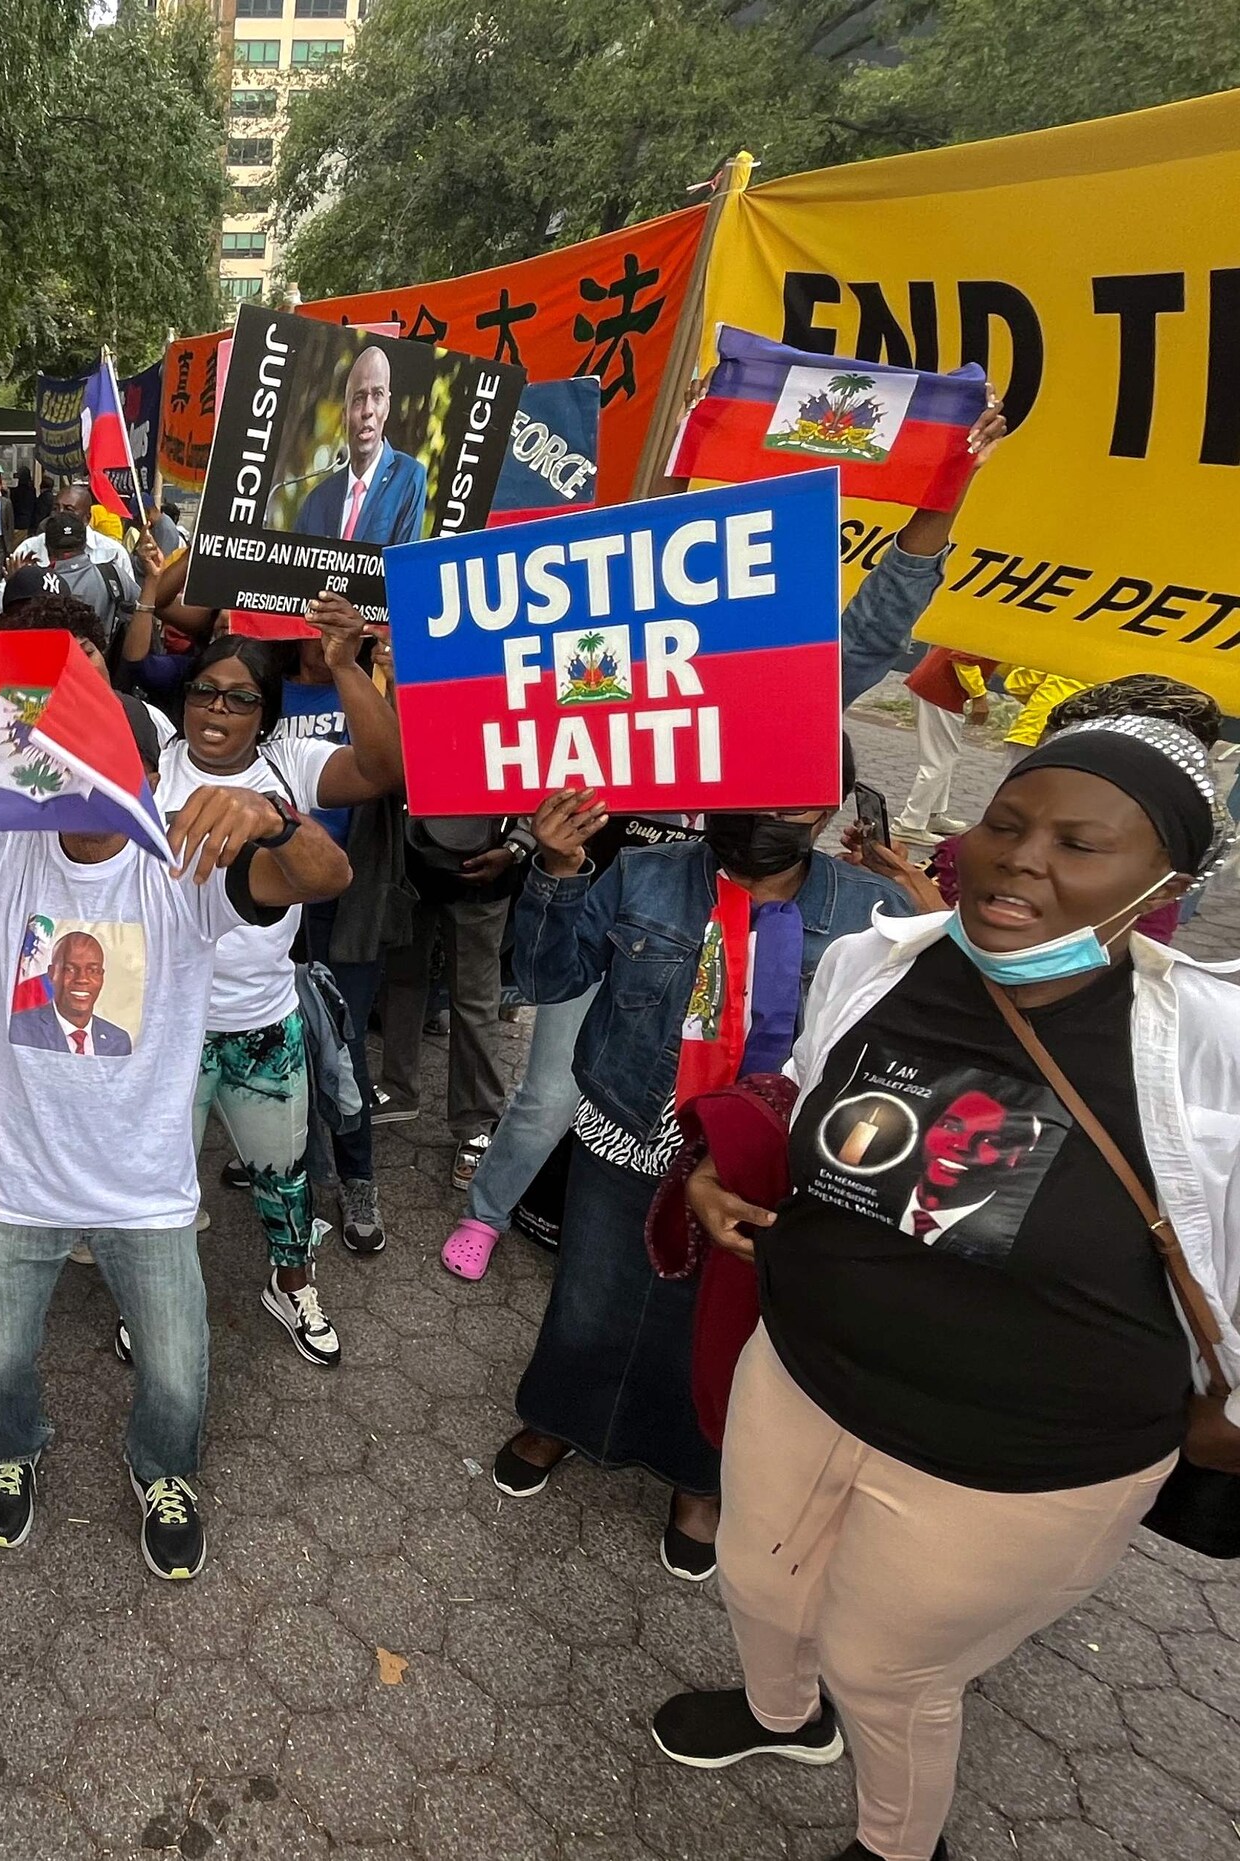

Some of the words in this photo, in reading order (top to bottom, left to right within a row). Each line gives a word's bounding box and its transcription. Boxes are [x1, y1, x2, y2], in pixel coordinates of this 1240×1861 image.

[230, 322, 291, 525] JUSTICE
[198, 533, 224, 557] WE
[225, 537, 266, 562] NEED
[267, 543, 290, 566] AN
[325, 575, 349, 593] FOR
[427, 510, 777, 638] JUSTICE
[949, 548, 1103, 613] THE
[235, 591, 300, 614] PRESIDENT
[482, 706, 722, 792] HAITI
[625, 820, 662, 844] July
[895, 1066, 919, 1080] AN
[903, 1083, 932, 1098] 2022
